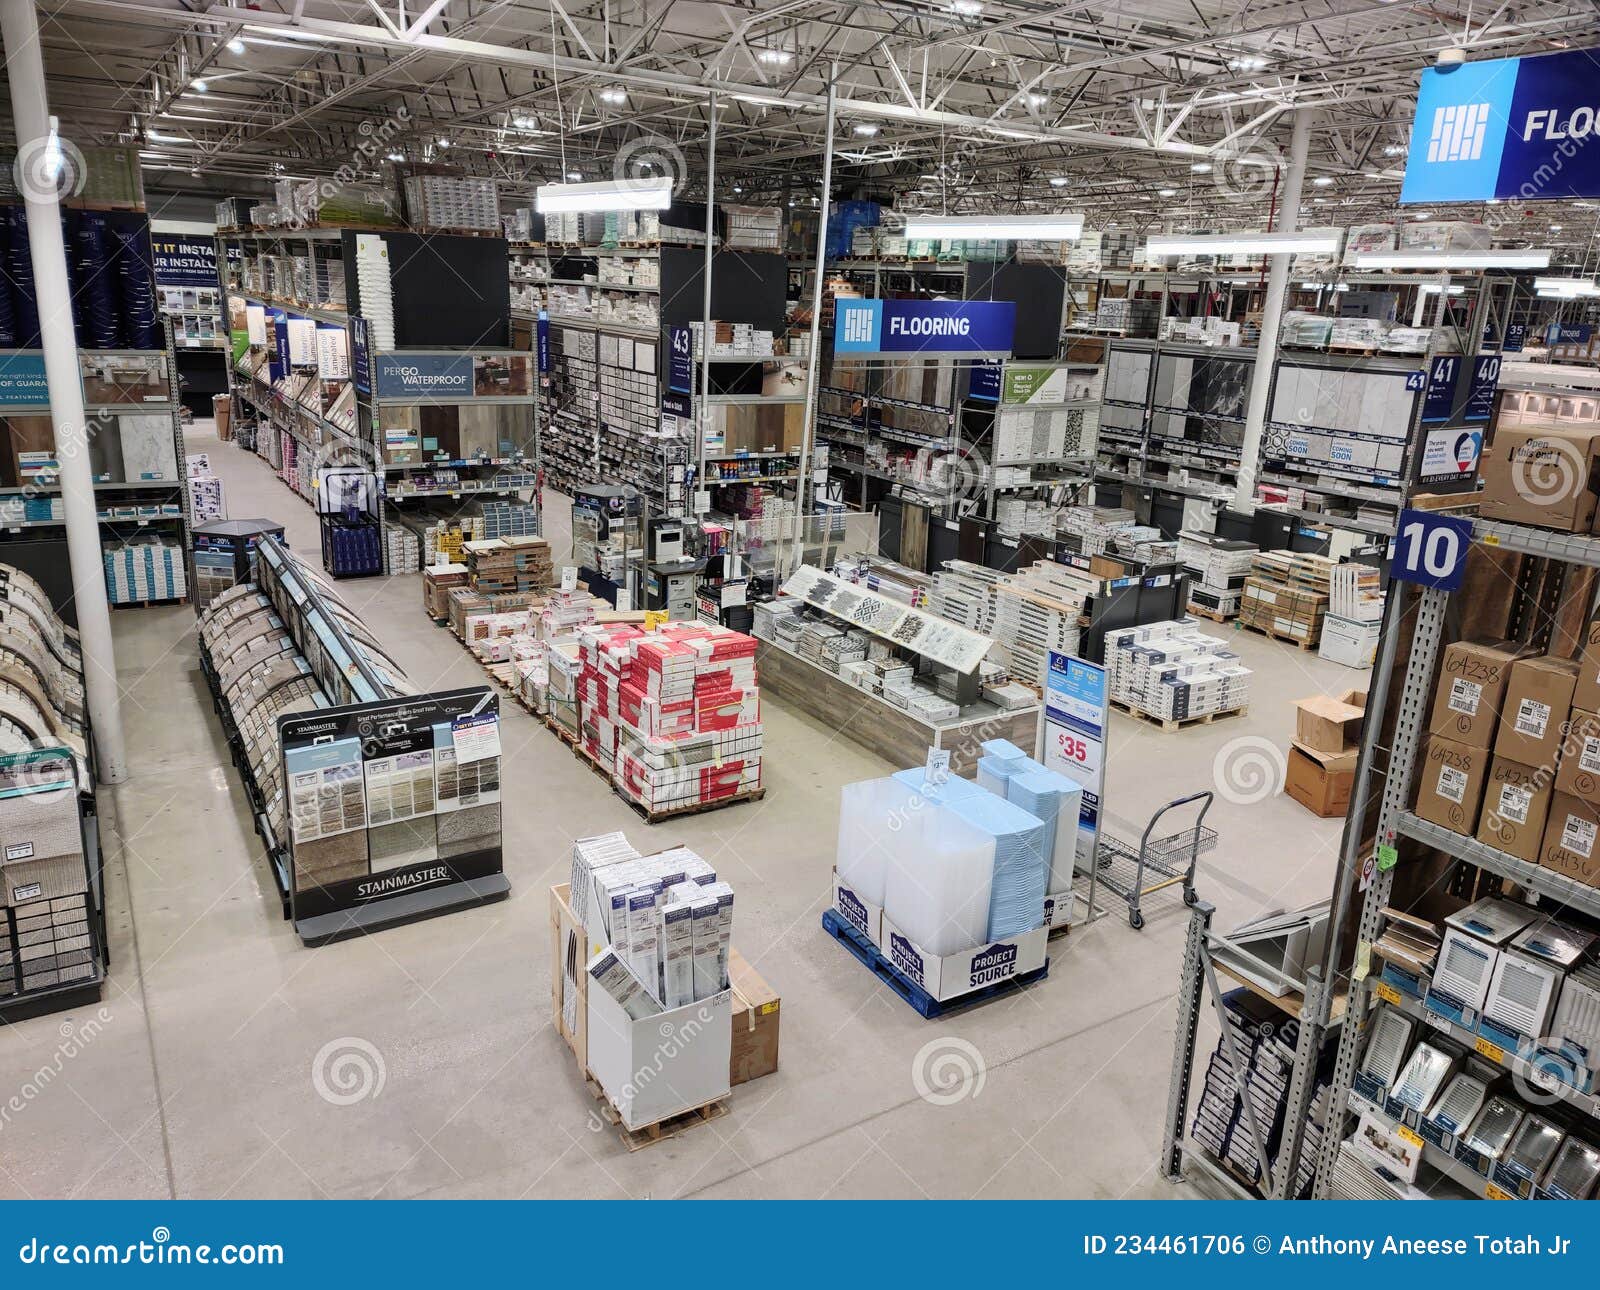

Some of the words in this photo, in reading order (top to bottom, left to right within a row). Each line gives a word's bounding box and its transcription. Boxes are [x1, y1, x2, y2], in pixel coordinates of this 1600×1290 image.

[1523, 106, 1600, 142] FLO
[890, 316, 970, 336] FLOORING
[1509, 325, 1524, 335] 35
[673, 329, 689, 354] 43
[384, 366, 419, 376] PERGO
[401, 375, 467, 385] WATERPROOF
[1407, 374, 1425, 388] 41
[1434, 358, 1454, 382] 41
[1478, 358, 1498, 381] 40
[1287, 445, 1308, 454] SOON
[1331, 451, 1352, 461] SOON
[1332, 446, 1353, 454] COMING
[1403, 522, 1459, 578] 10
[1446, 652, 1499, 684] 64238
[1058, 733, 1087, 762] $35
[1430, 743, 1472, 771] 64238
[1547, 846, 1593, 876] 64136
[357, 865, 447, 896] STAINMASTER
[839, 902, 871, 937] SOURCE
[892, 936, 921, 968] PROJECT
[974, 948, 1015, 970] PROJECT
[890, 948, 926, 989] SOURCE
[969, 961, 1016, 988] SOURCE
